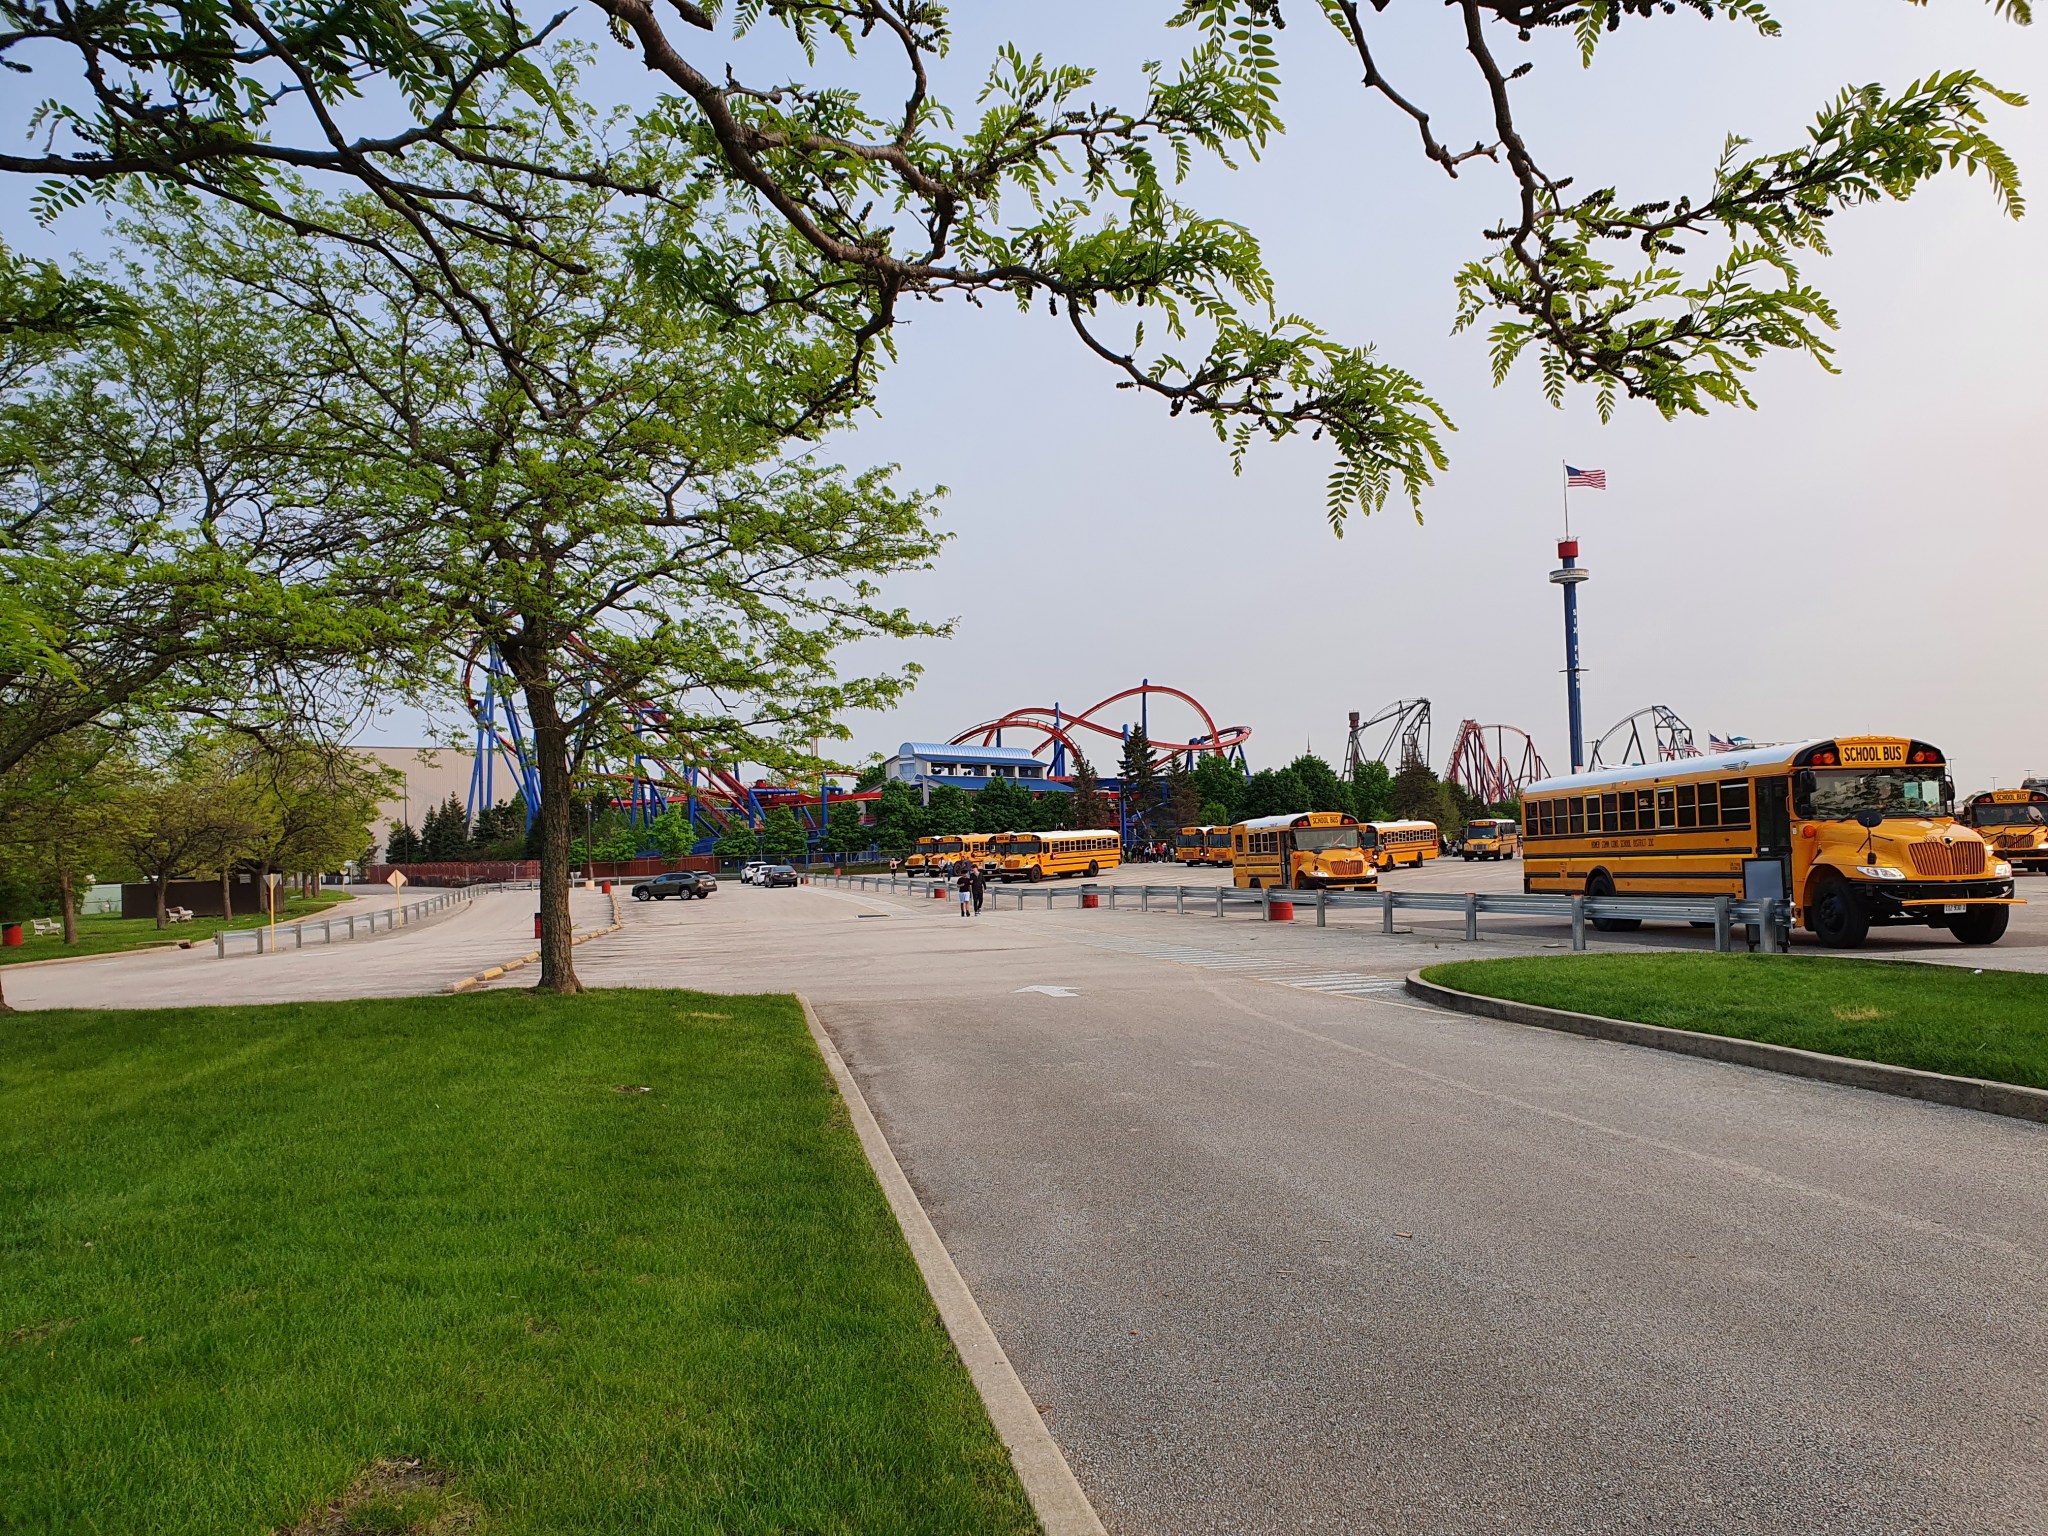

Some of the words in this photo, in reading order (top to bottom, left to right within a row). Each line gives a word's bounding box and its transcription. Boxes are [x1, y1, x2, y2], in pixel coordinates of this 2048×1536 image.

[1844, 746, 1881, 762] SCHOOL
[1883, 745, 1902, 761] BUS
[1996, 793, 2015, 801] SCHOOL
[1312, 817, 1329, 825] SCHOOL
[1330, 816, 1339, 824] BUS
